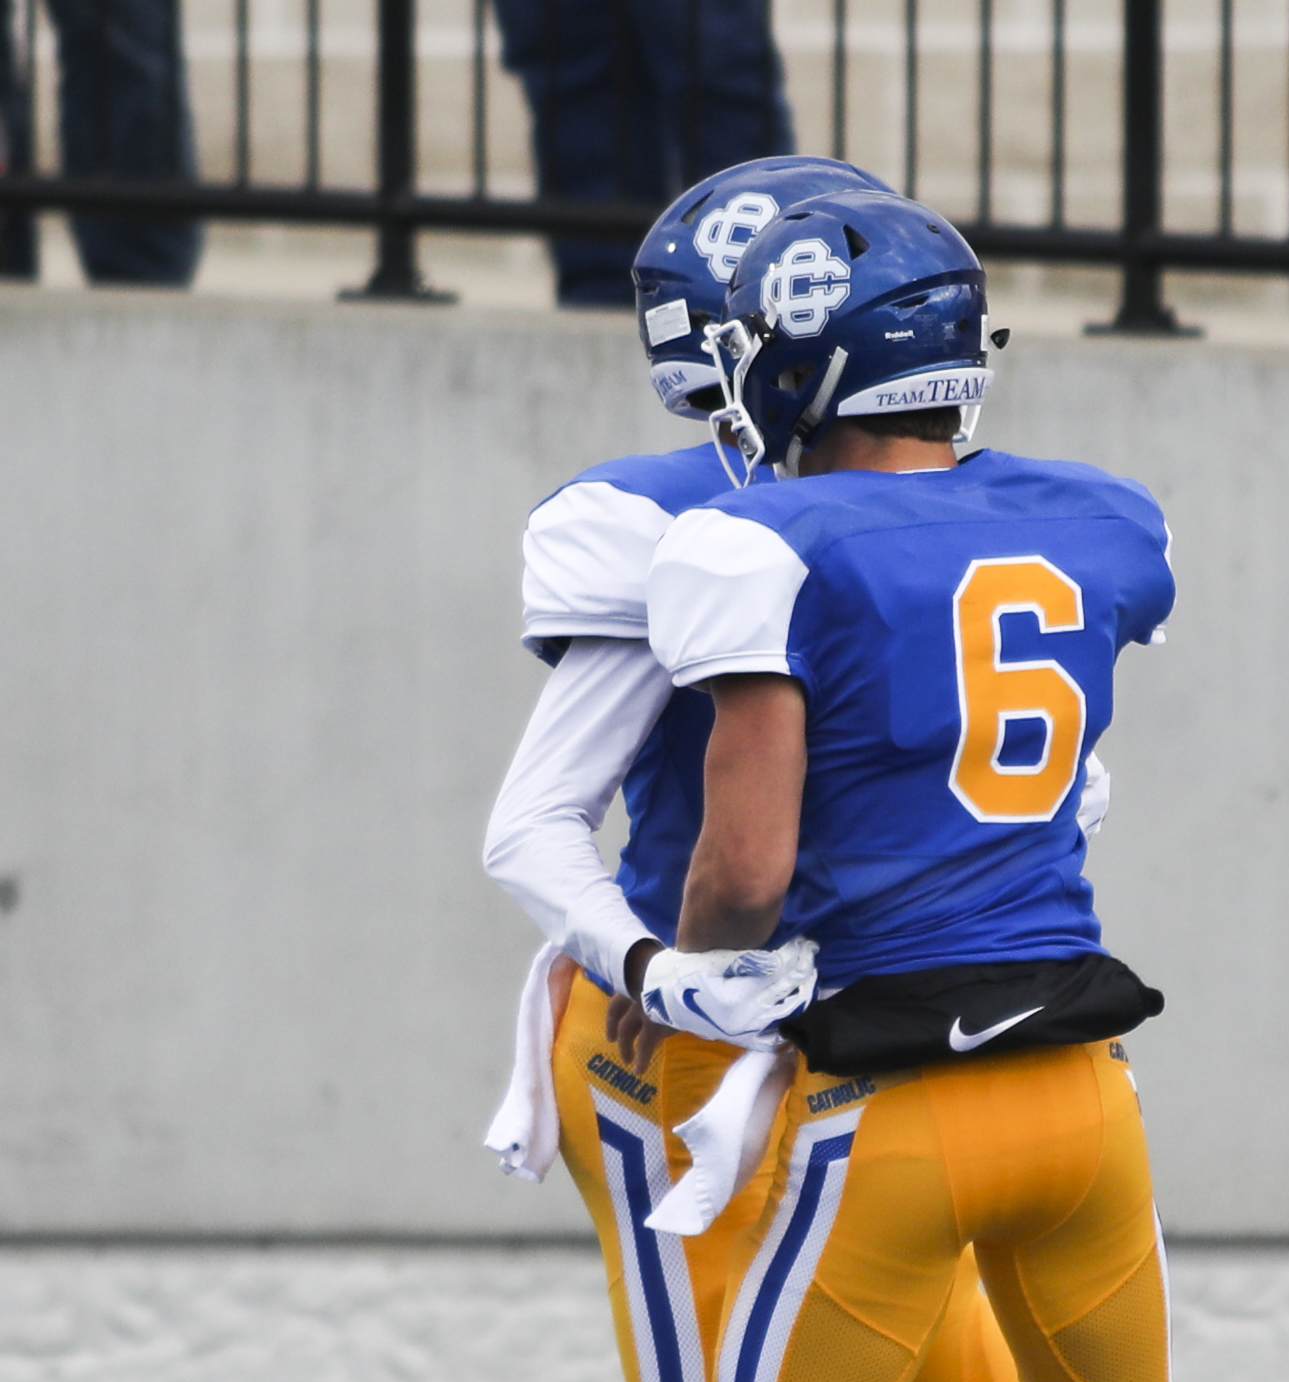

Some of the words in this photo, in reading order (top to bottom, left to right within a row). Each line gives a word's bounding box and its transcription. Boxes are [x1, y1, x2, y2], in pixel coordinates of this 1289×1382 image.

[949, 555, 1087, 823] 6
[588, 1053, 657, 1105] CATHOLIC
[807, 1074, 876, 1114] CATHOLIC
